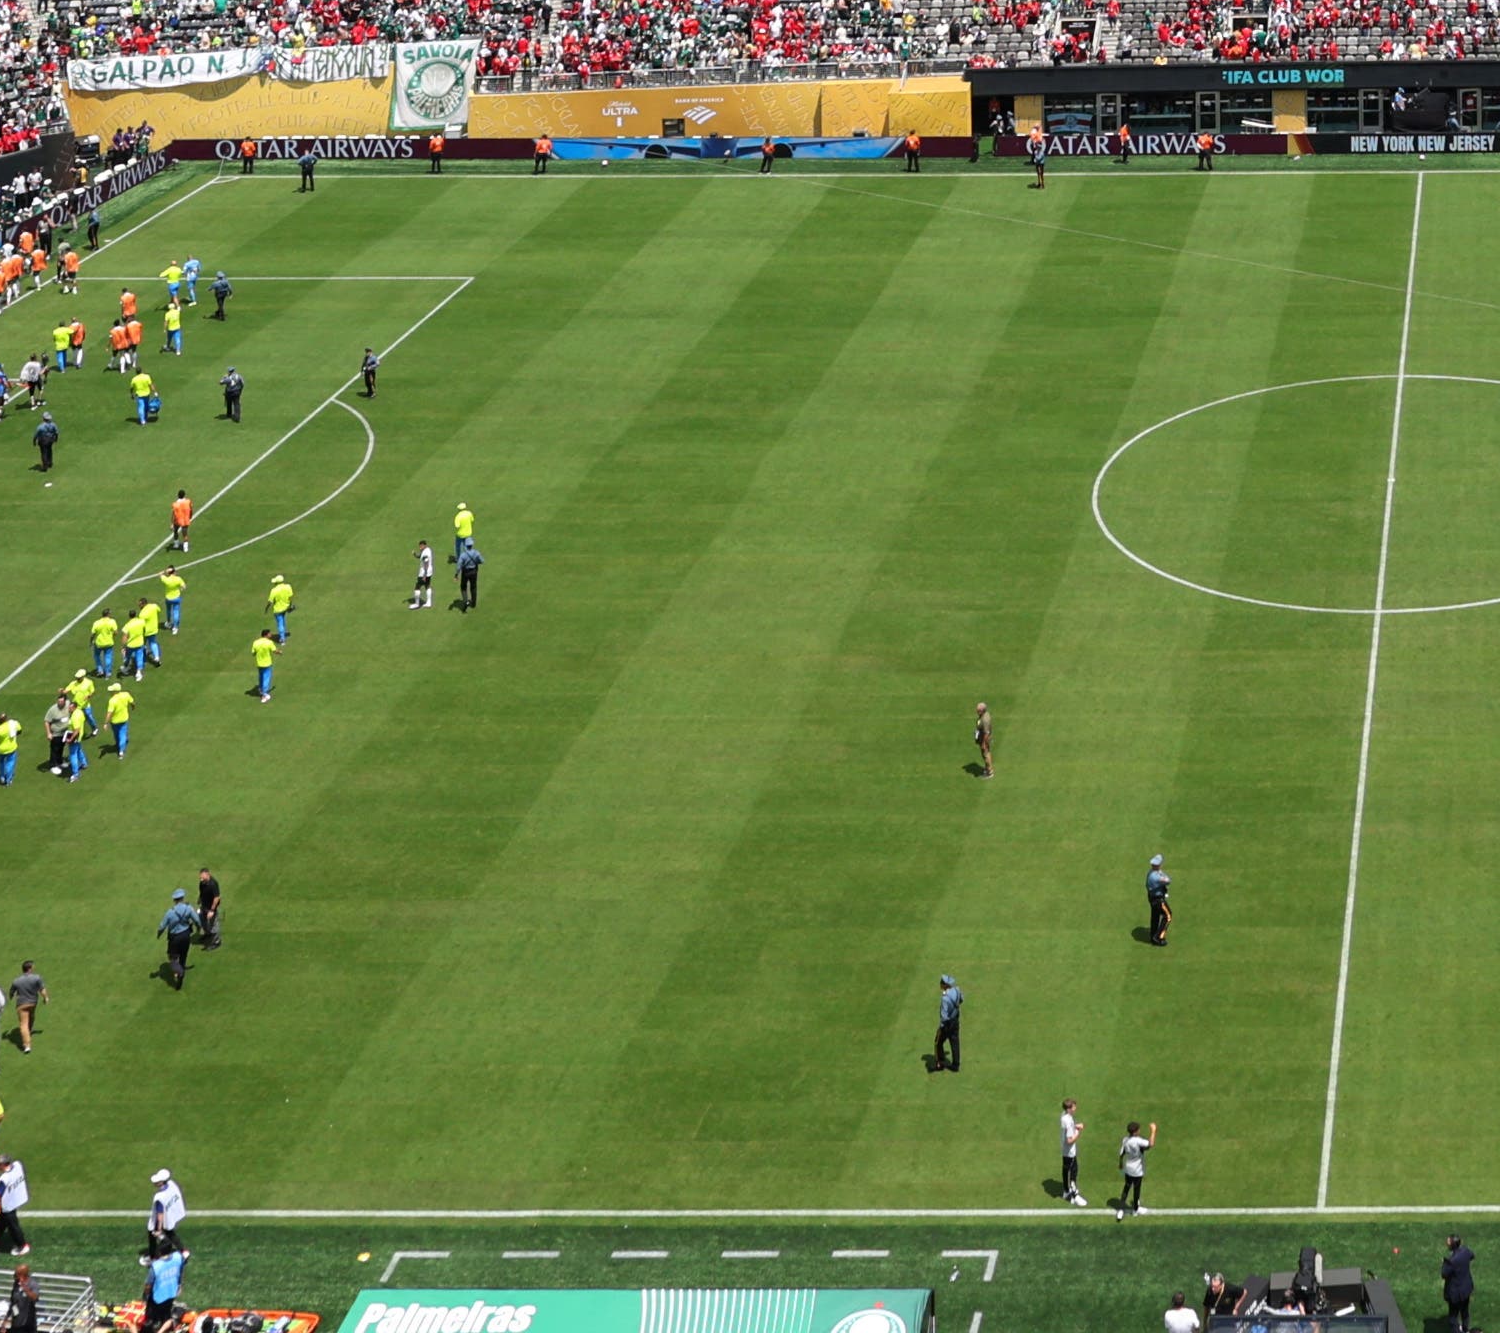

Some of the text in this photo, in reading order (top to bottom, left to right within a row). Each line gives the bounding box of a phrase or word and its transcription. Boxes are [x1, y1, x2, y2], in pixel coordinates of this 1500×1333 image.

[403, 44, 474, 65] SAVOIA
[1257, 69, 1302, 85] CLUB
[1305, 69, 1344, 84] WOR
[602, 107, 639, 116] ULTRA
[216, 138, 414, 159] QTAR AIRWAYS
[1120, 134, 1226, 155] AIRWAS
[1351, 135, 1496, 153] NEW YORK NEW JERSEY
[50, 149, 167, 228] QTAR AIRWAYS
[353, 1300, 536, 1333] Palmeiras
